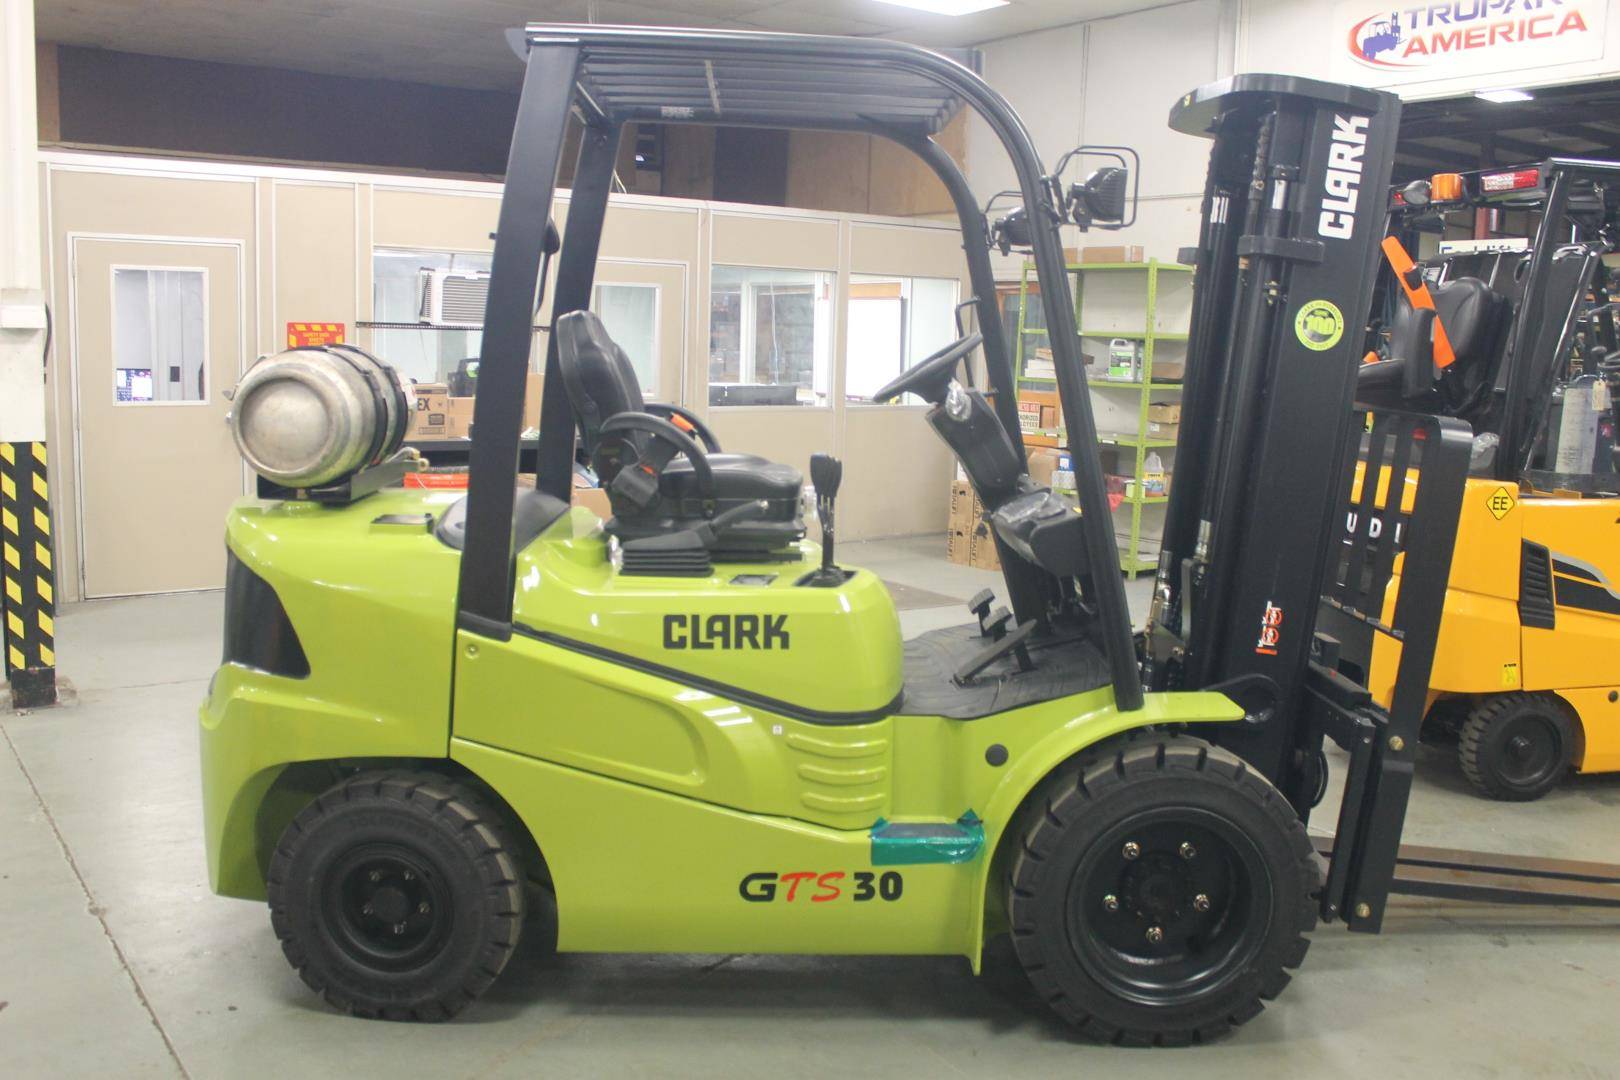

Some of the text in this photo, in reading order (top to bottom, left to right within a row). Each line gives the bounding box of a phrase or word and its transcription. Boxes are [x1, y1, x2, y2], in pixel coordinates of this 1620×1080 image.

[1402, 9, 1588, 58] AMERICA
[1317, 113, 1370, 240] CLARK
[1492, 496, 1509, 511] EE
[662, 614, 790, 650] CLARK
[739, 871, 904, 903] GTS 30
